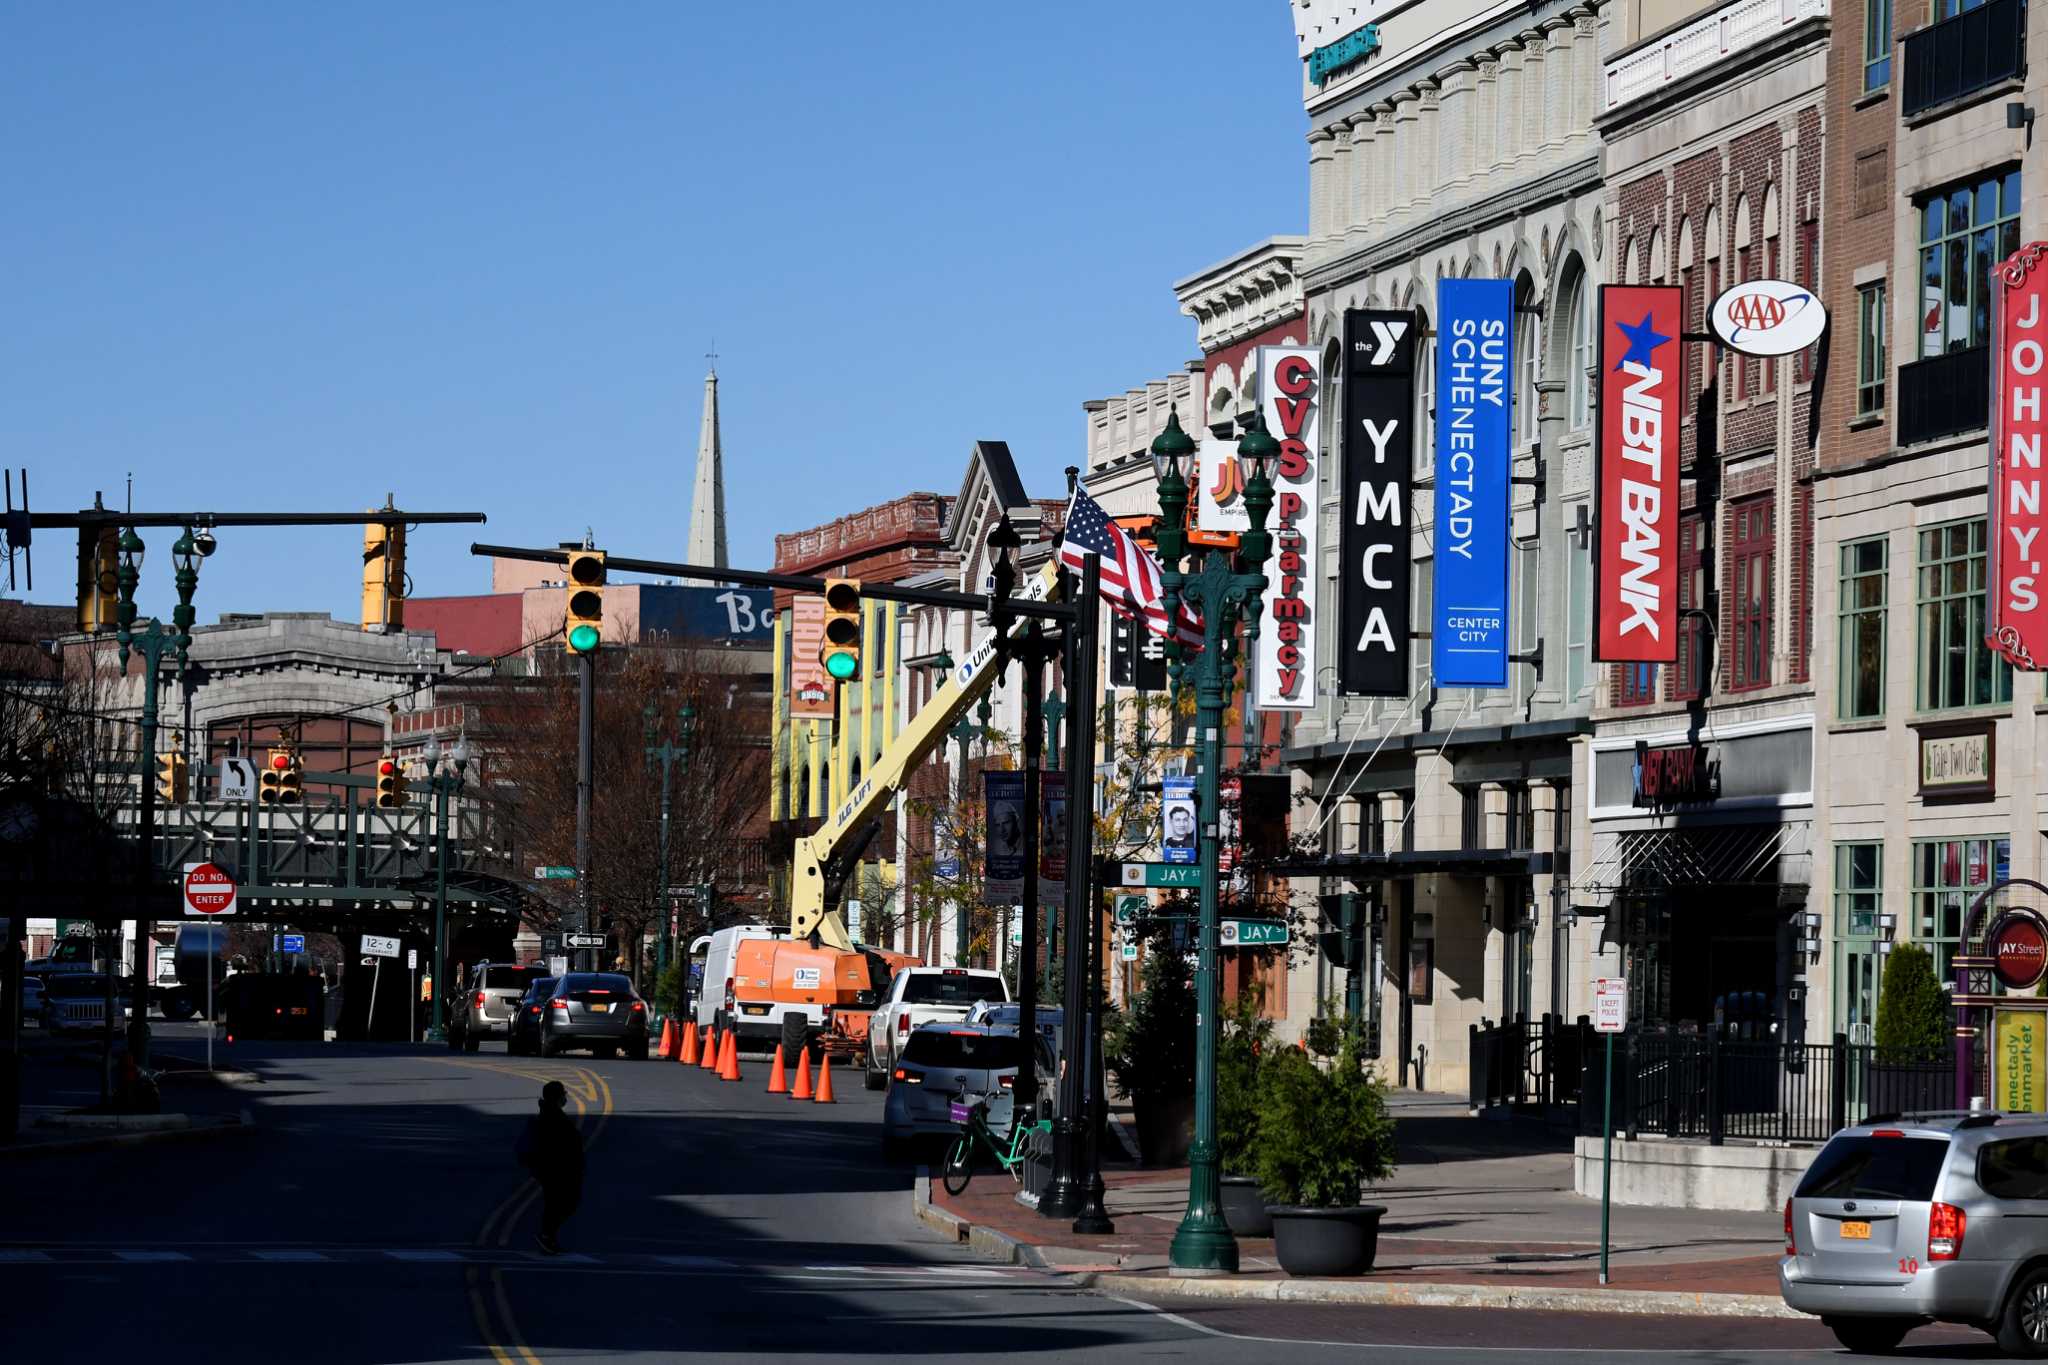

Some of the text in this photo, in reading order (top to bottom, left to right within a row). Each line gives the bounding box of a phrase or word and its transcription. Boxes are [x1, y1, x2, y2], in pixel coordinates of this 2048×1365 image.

[1730, 294, 1784, 330] AAA
[1355, 341, 1373, 351] the
[1480, 319, 1504, 408] SUNY
[1274, 355, 1313, 478] CVS
[1449, 319, 1476, 560] SCHENECTADY
[2009, 294, 2044, 612] JOHNNY'S
[1619, 359, 1663, 643] NBT BANK
[1356, 418, 1402, 652] YMCA
[1447, 617, 1500, 630] CENTER
[1459, 630, 1489, 642] CITY
[225, 788, 248, 797] ONLY
[854, 779, 871, 807] LIFT
[193, 873, 205, 881] DO
[1160, 869, 1188, 881] JAY
[195, 895, 225, 904] ENTER
[1243, 925, 1272, 939] JAY
[1998, 943, 2043, 956] JAY Street
[1898, 1257, 1919, 1275] 10
